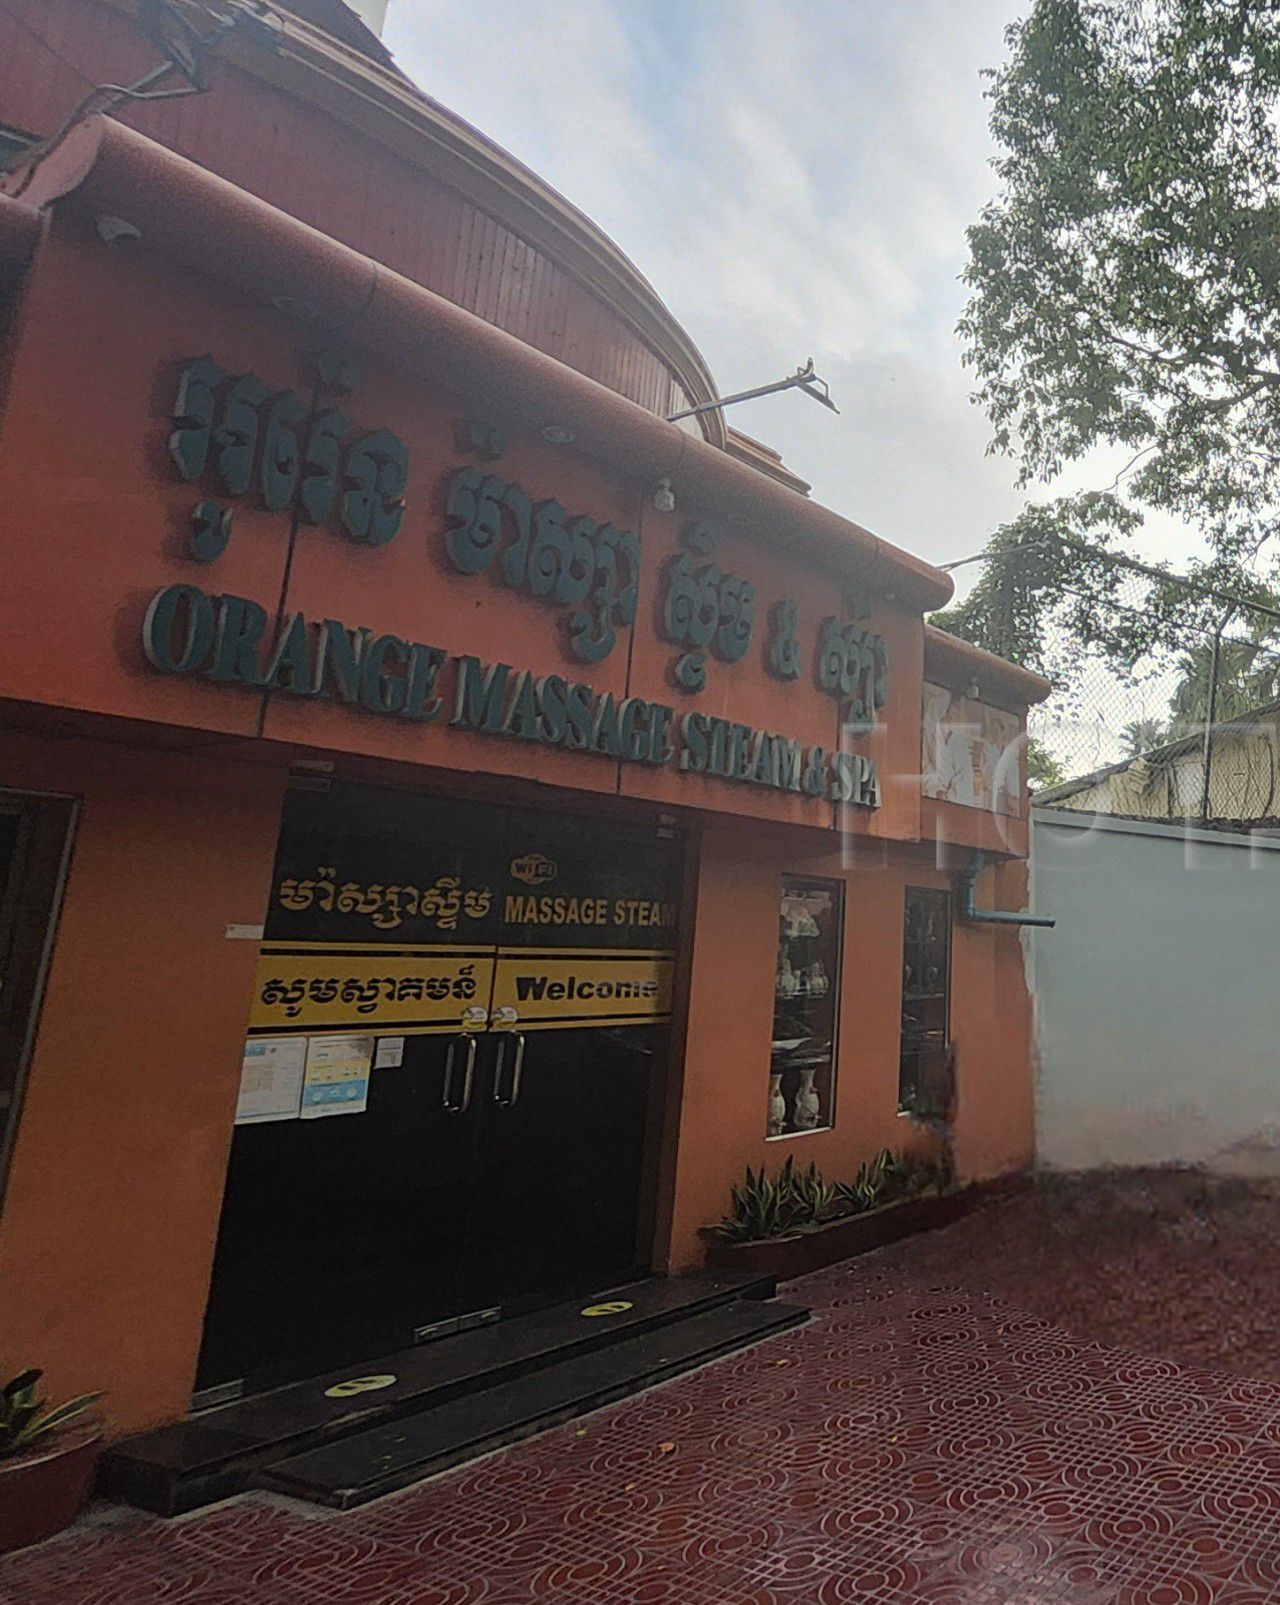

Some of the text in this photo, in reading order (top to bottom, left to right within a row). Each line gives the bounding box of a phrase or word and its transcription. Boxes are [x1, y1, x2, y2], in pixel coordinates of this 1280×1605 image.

[774, 600, 802, 679] &
[145, 583, 883, 809] ORANGE MASSAGE STEAM & SPA
[505, 896, 607, 925] MASSAGE
[516, 975, 658, 1001] Welcome
